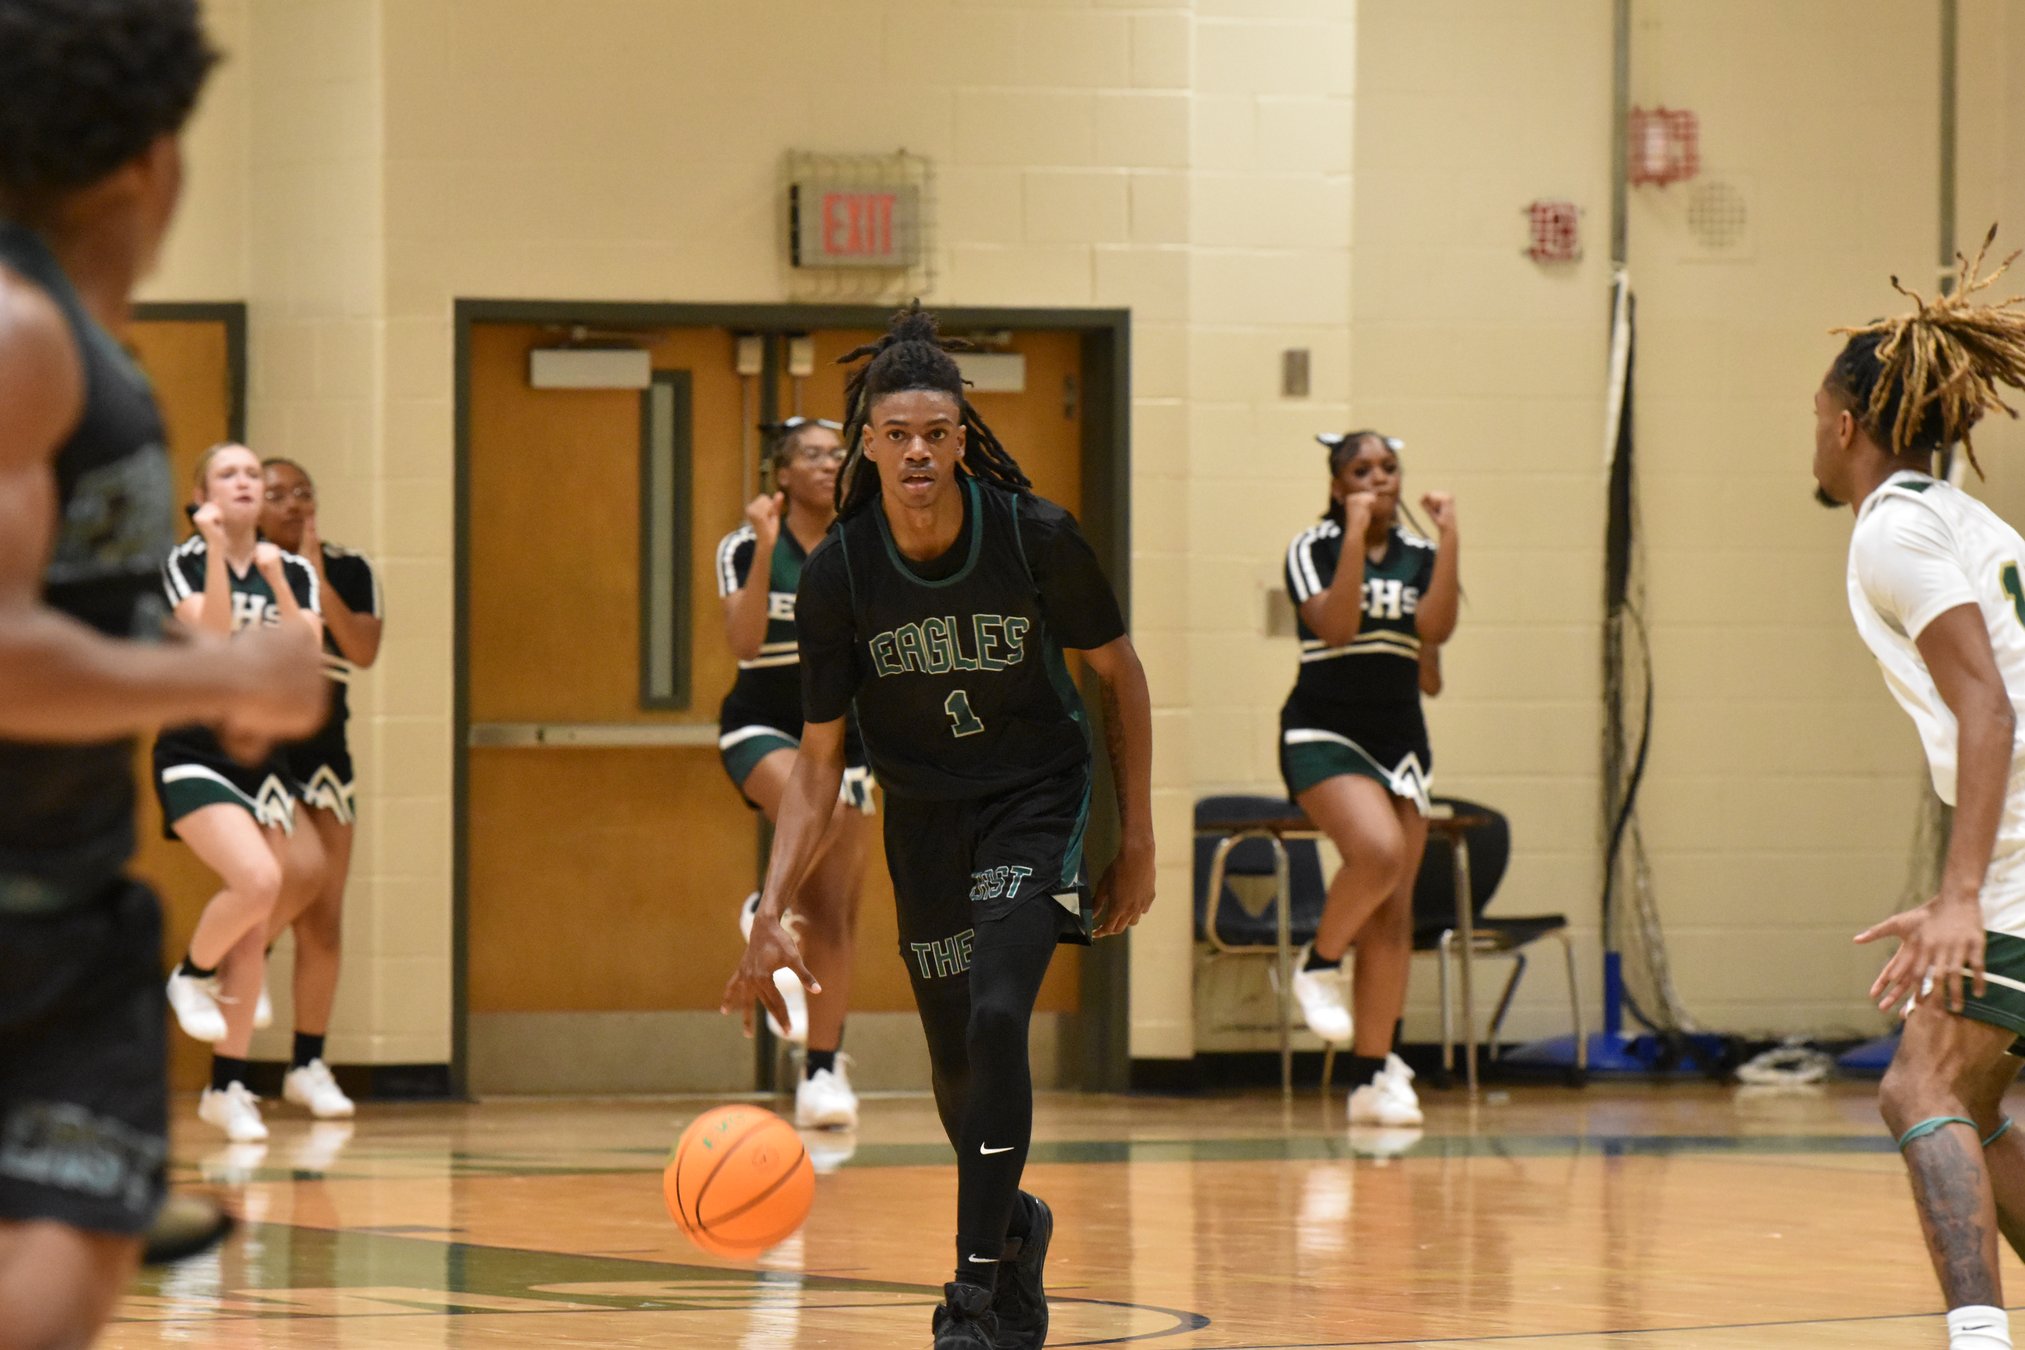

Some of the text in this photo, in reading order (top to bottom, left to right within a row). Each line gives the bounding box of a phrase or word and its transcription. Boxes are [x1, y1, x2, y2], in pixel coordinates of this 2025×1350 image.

[822, 192, 896, 256] EXIT
[1360, 578, 1419, 619] HS
[868, 613, 1030, 678] EAGLES
[944, 689, 985, 738] 1
[910, 928, 976, 979] THE
